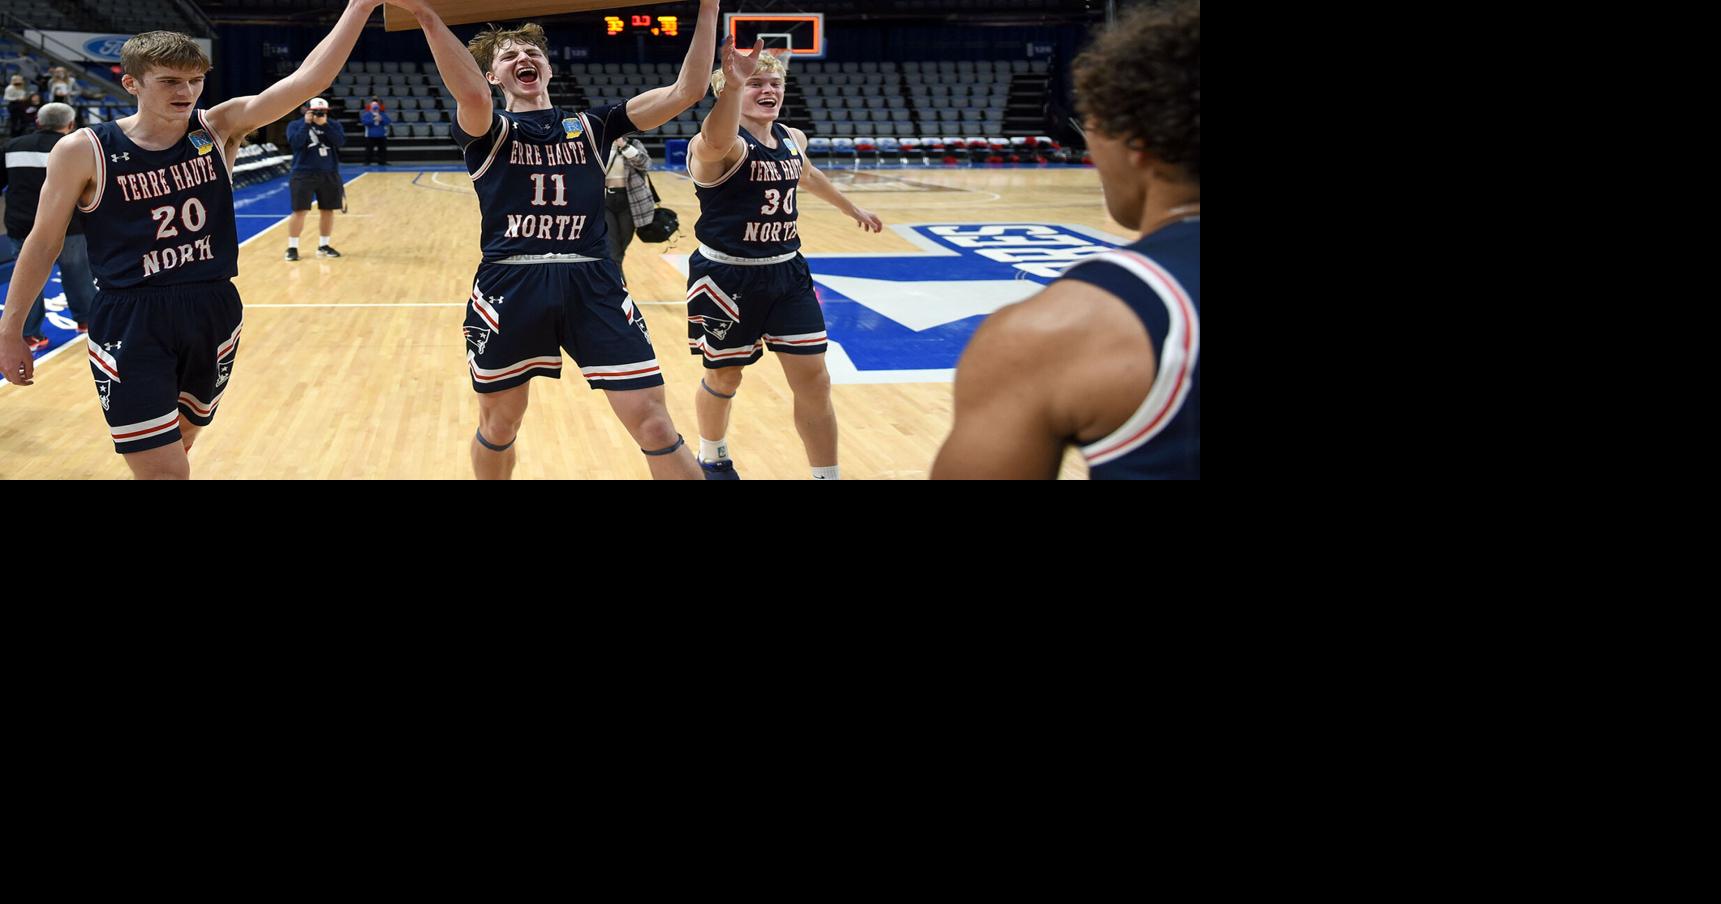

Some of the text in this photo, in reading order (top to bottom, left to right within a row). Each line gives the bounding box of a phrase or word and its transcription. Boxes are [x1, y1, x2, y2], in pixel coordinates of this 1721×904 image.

[510, 140, 587, 166] ERRE HAUTE
[117, 155, 217, 201] TERRE HAUTE
[530, 173, 568, 206] 11
[761, 187, 795, 215] 30
[151, 197, 207, 240] 20
[504, 214, 587, 240] NORTH
